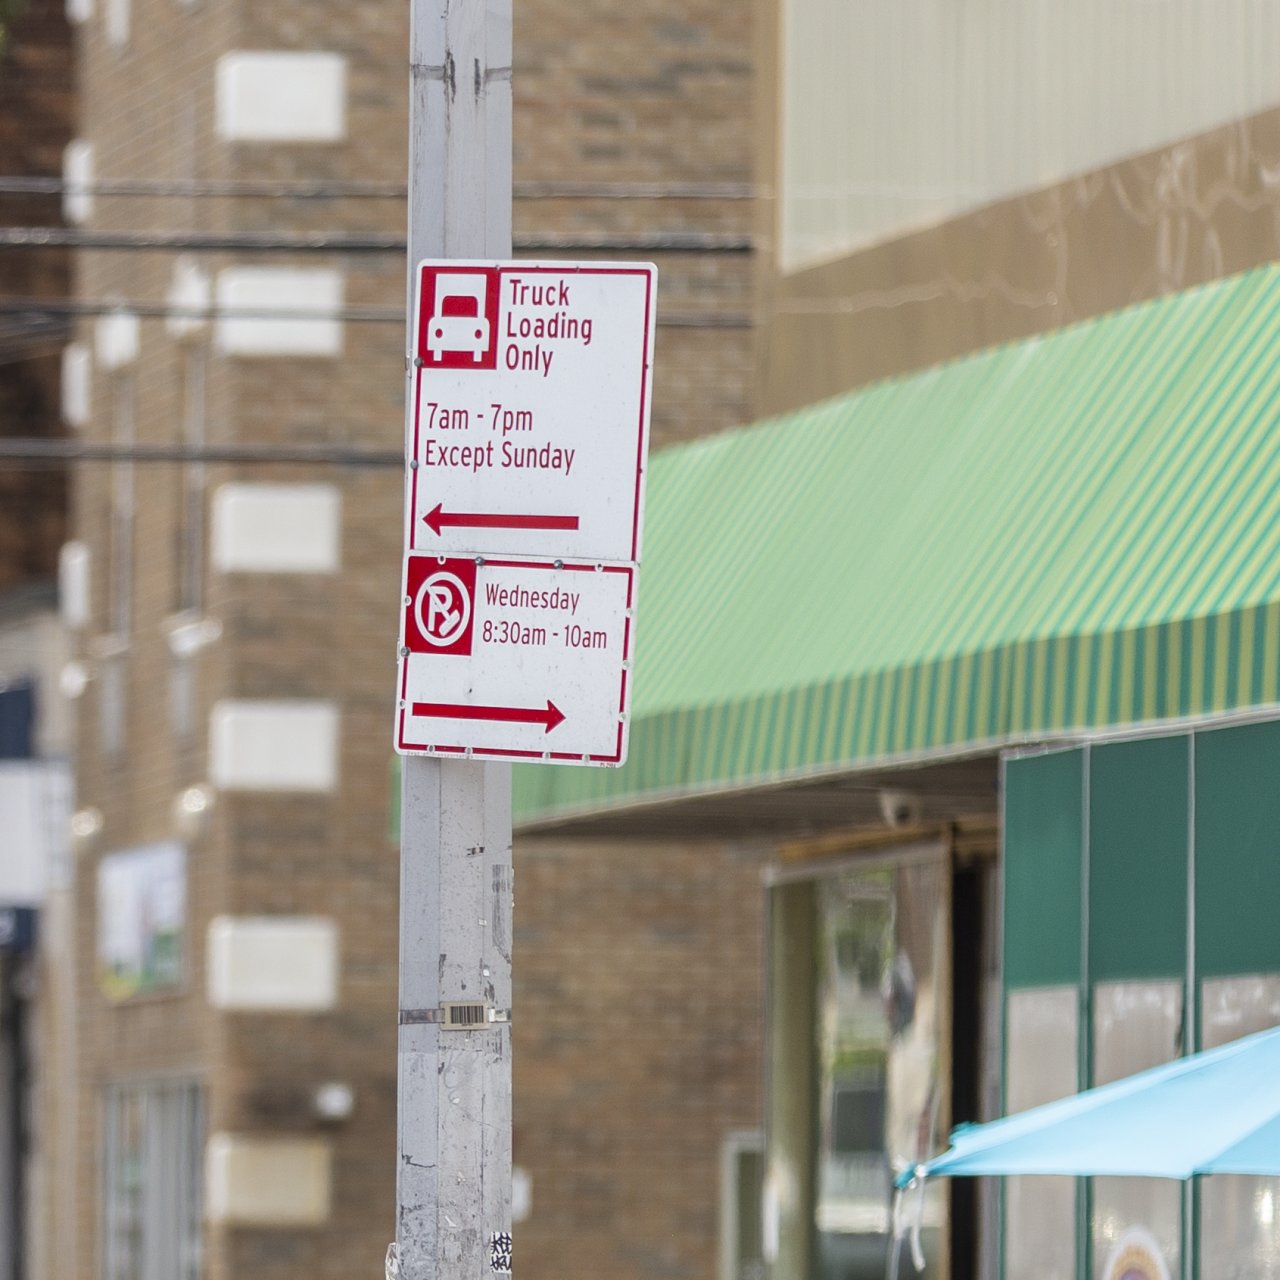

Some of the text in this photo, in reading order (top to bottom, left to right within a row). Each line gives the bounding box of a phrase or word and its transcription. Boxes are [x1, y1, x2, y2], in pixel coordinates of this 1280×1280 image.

[509, 279, 570, 306] Truck
[506, 311, 593, 345] Loading
[505, 343, 553, 377] Only
[427, 402, 469, 430] 7am
[490, 403, 533, 436] 7pm
[425, 439, 575, 476] Except Sunday
[485, 583, 580, 616] Wednesday
[482, 620, 546, 646] 8:30am
[563, 624, 608, 649] 10am
